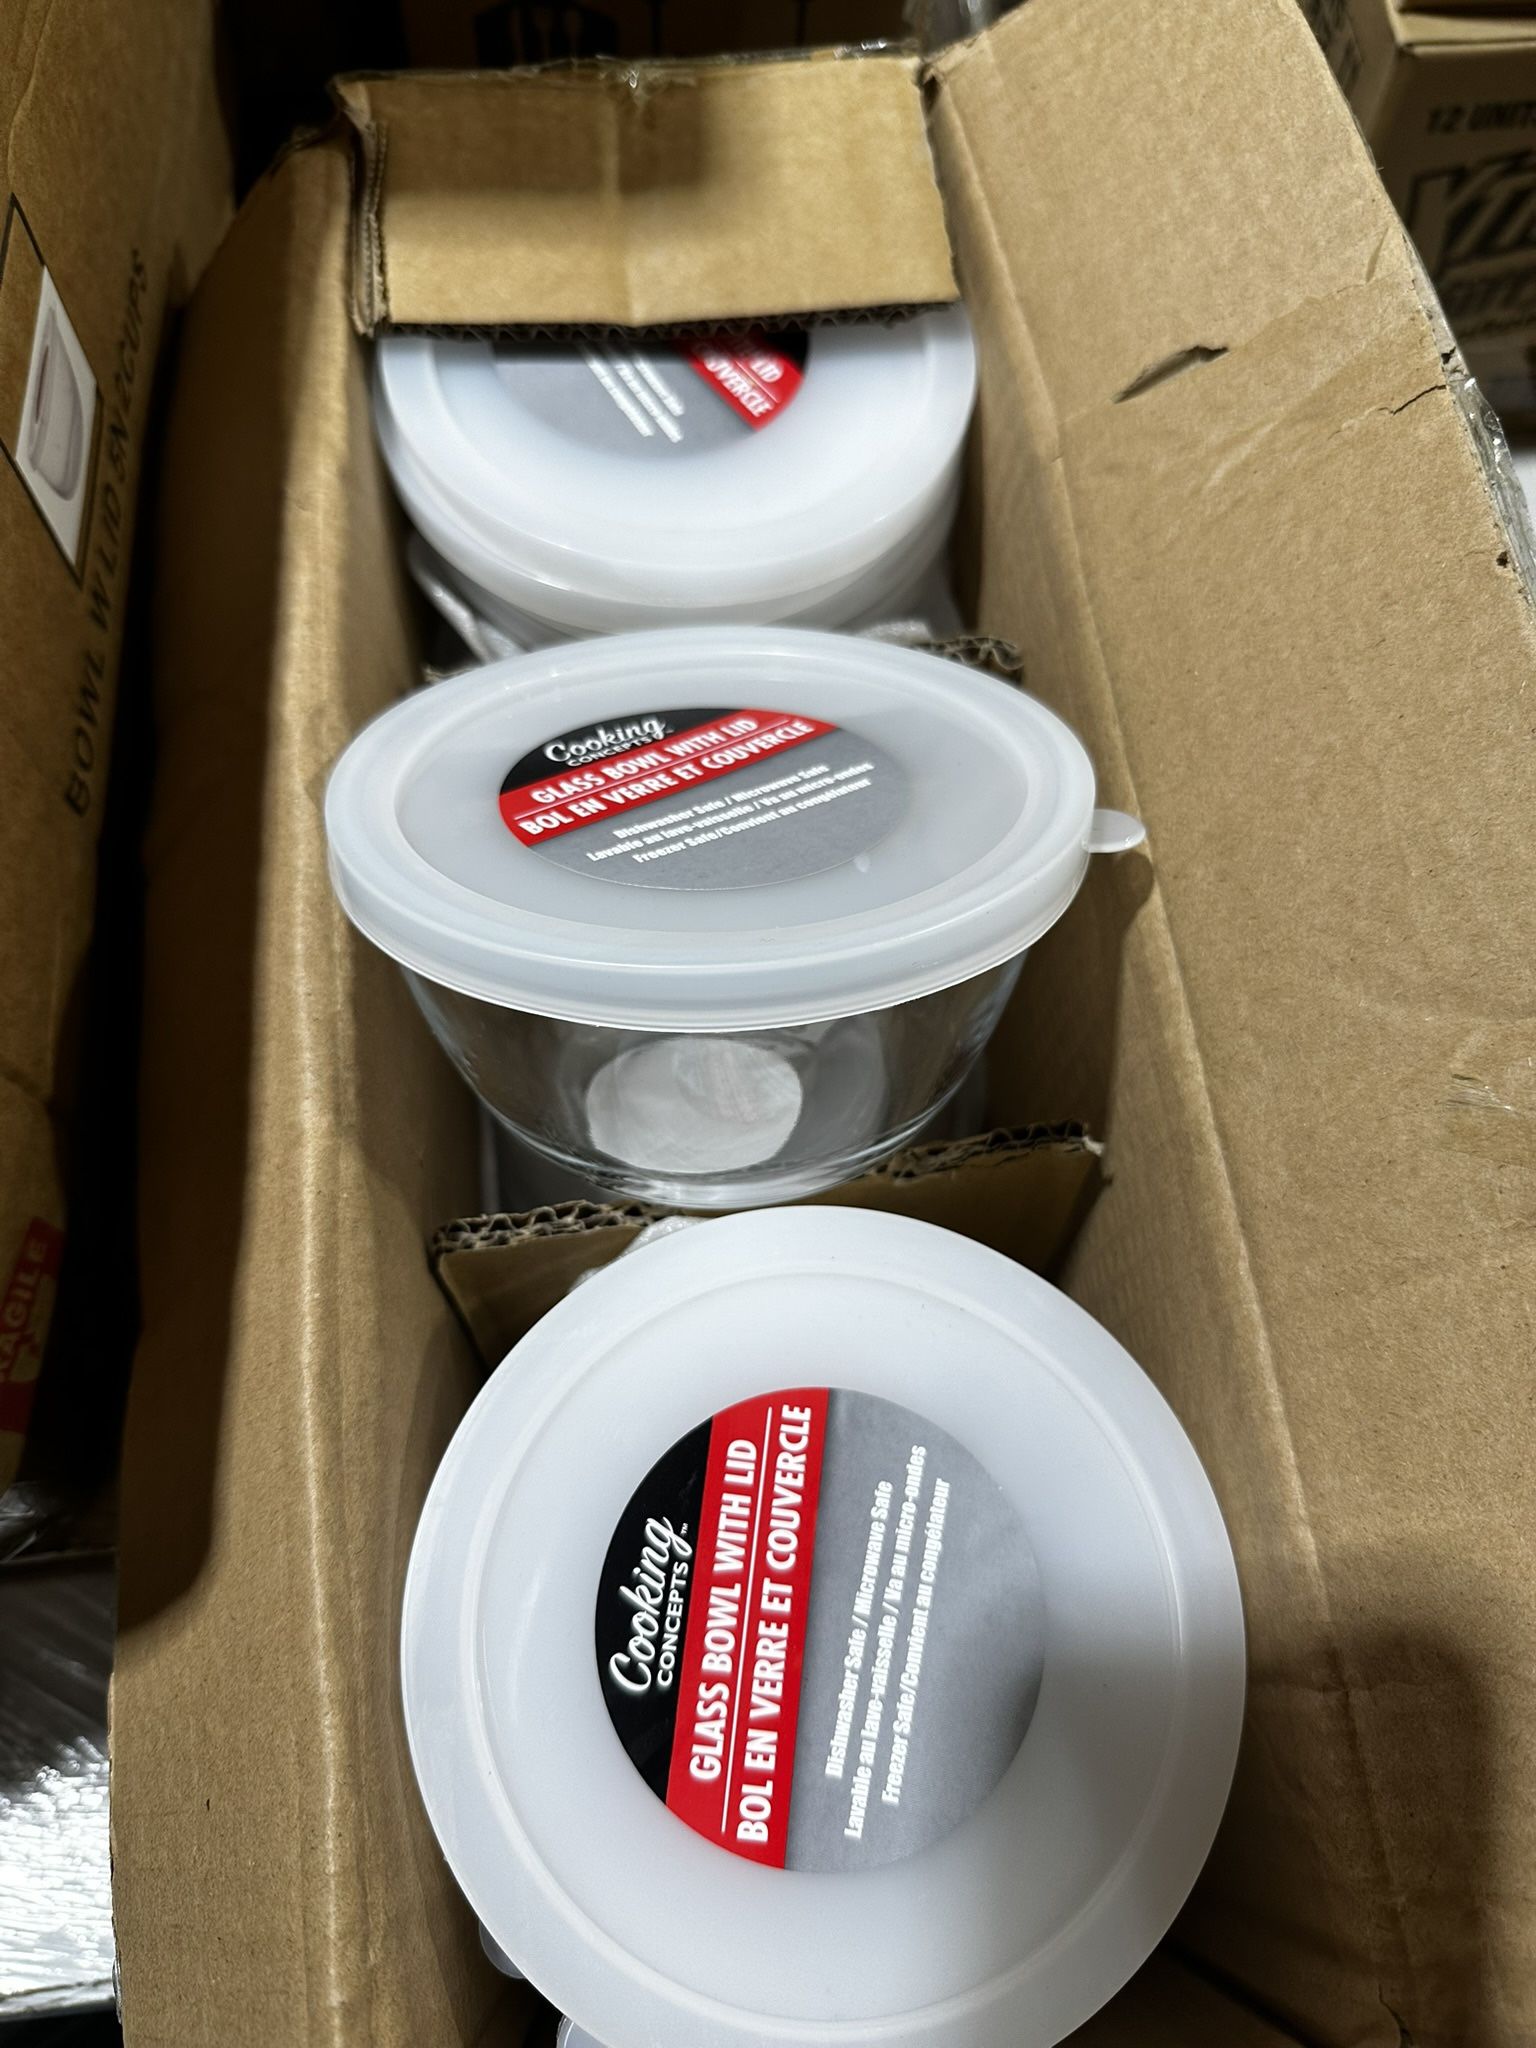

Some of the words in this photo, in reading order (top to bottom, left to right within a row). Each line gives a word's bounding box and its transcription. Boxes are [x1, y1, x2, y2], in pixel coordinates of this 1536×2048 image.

[750, 352, 783, 383] LID
[64, 650, 105, 818] BOWL
[531, 773, 605, 803] GLASS
[601, 752, 672, 780] BOWL
[664, 731, 727, 757] WITH
[720, 719, 759, 737] LID
[545, 717, 666, 762] Cooking
[566, 737, 654, 767] CONCEPTS
[518, 811, 575, 835] BOL
[567, 798, 608, 818] EN
[600, 773, 679, 804] VERRE
[672, 763, 704, 780] ET
[701, 721, 816, 769] COUVERCLE
[724, 1438, 758, 1486] LID
[765, 1403, 812, 1571] COUVERCLE
[895, 1444, 927, 1553] micro-ondes
[713, 1495, 752, 1575] WITH
[871, 1480, 893, 1521] Safe
[920, 1477, 950, 1583] congélateur
[609, 1515, 692, 1692] Cooking
[762, 1576, 793, 1615] ET
[853, 1520, 886, 1616] Microwave
[883, 1579, 904, 1601] Va
[891, 1555, 908, 1579] au
[916, 1583, 933, 1608] au
[656, 1561, 690, 1690] CONCEPTS
[701, 1581, 742, 1674] BOWL
[844, 1628, 867, 1670] Safe
[748, 1618, 791, 1720] VERRE
[689, 1682, 729, 1781] GLASS
[743, 1727, 778, 1772] EN
[825, 1670, 859, 1778] Dishwasher
[859, 1740, 877, 1766] au
[844, 1766, 872, 1839] Lavable
[882, 1735, 909, 1805] Freezer
[736, 1779, 774, 1843] BOL
